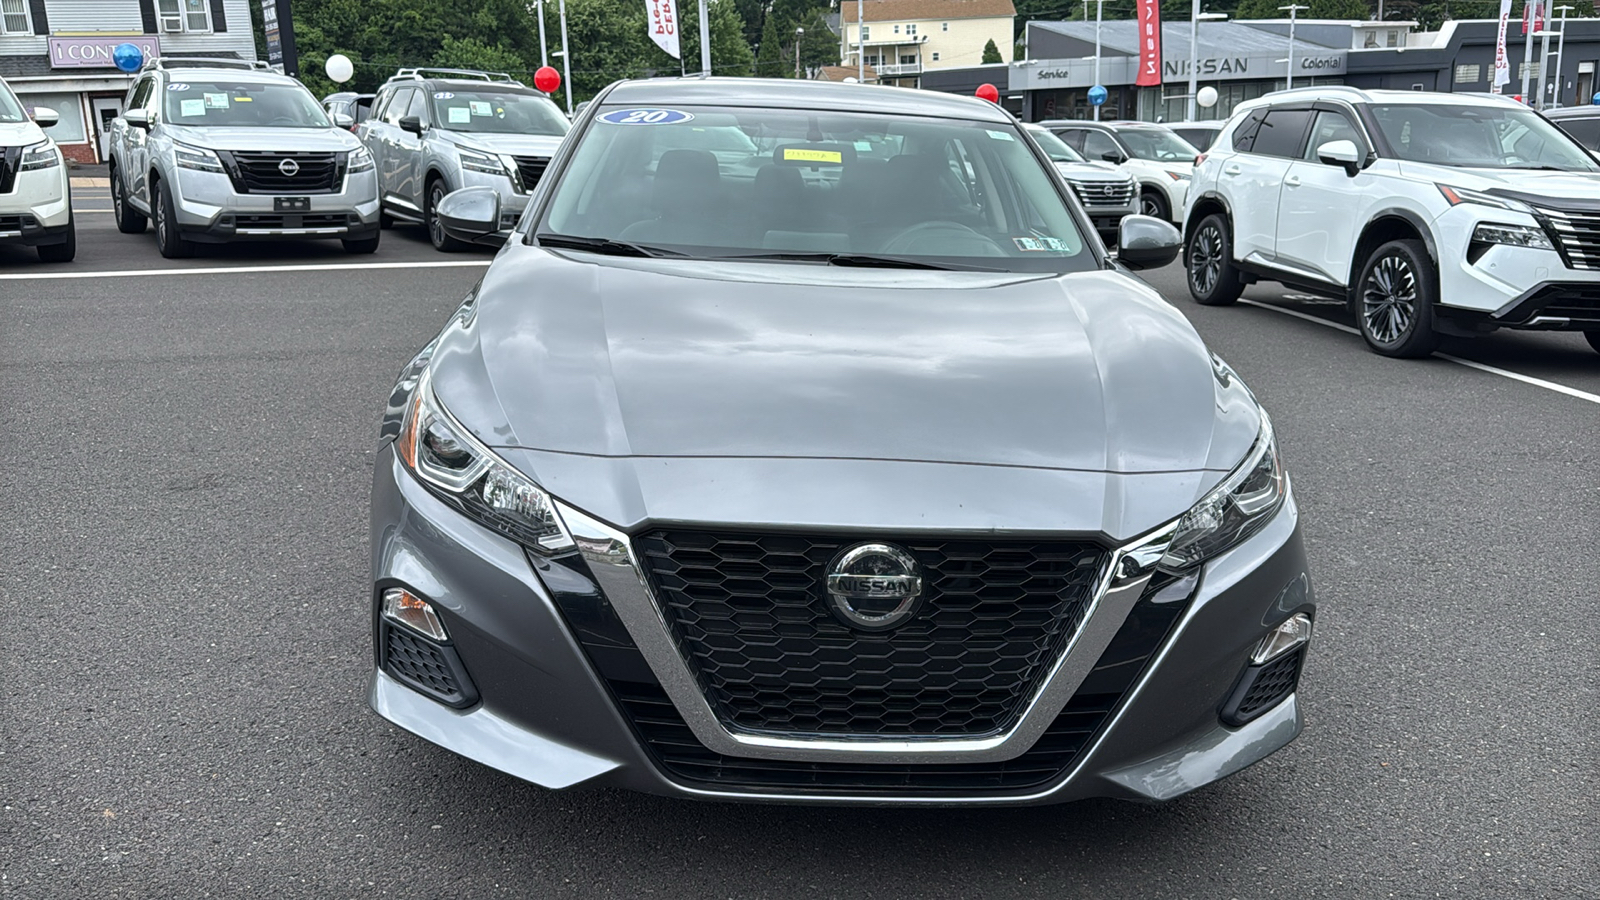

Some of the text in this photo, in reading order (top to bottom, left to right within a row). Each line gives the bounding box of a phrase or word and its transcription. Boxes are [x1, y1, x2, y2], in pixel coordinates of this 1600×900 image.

[68, 44, 153, 60] CONTR
[1164, 57, 1248, 76] NISSAN
[1301, 56, 1341, 69] Colonial
[1037, 69, 1069, 80] Service
[620, 110, 669, 123] 20
[838, 580, 912, 593] NISSAN
